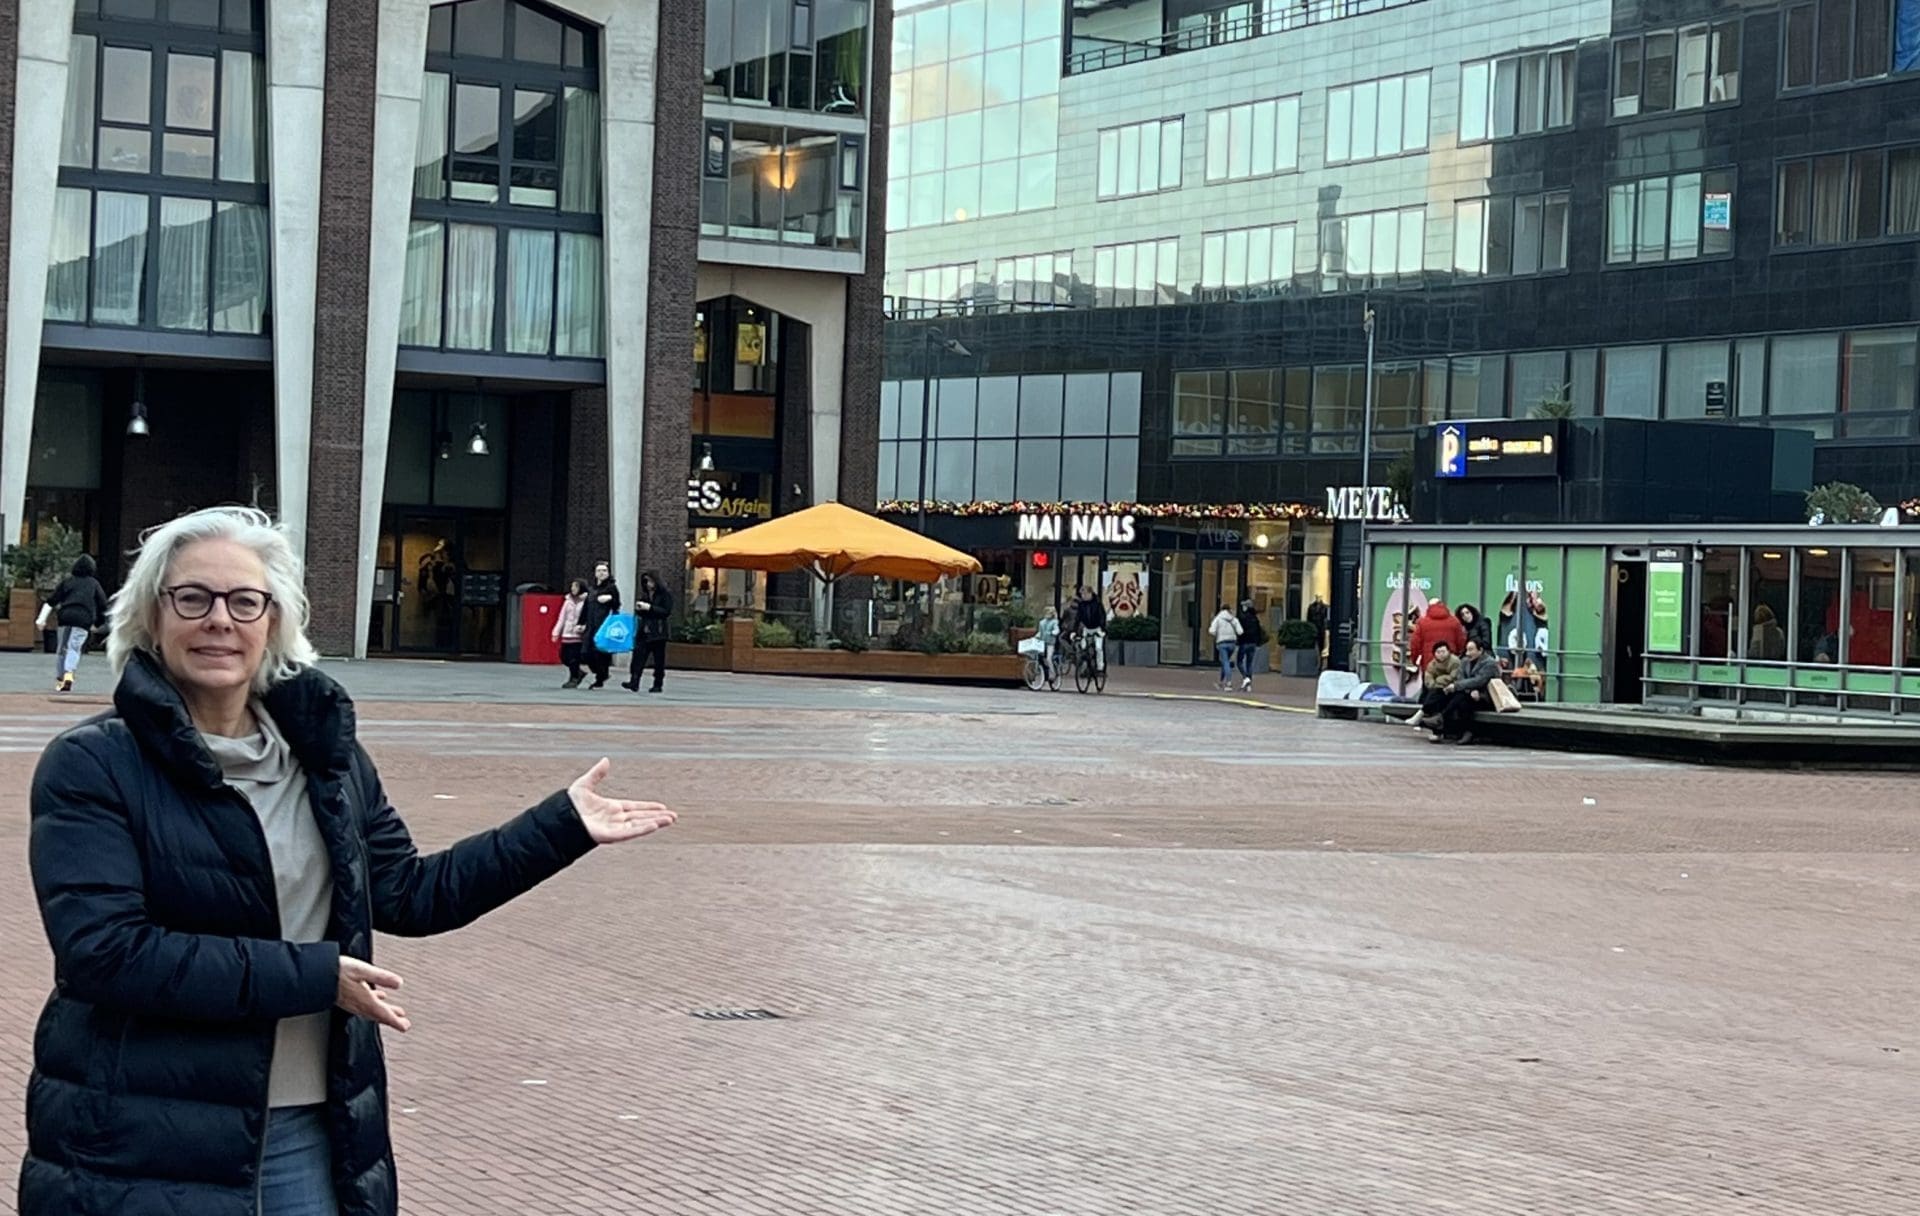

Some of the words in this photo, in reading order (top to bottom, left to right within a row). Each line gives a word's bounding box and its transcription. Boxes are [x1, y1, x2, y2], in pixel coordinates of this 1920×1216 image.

[1018, 514, 1060, 540] MAI
[1071, 514, 1135, 542] NAILS
[1386, 571, 1431, 590] deliious
[1506, 574, 1543, 592] flaors
